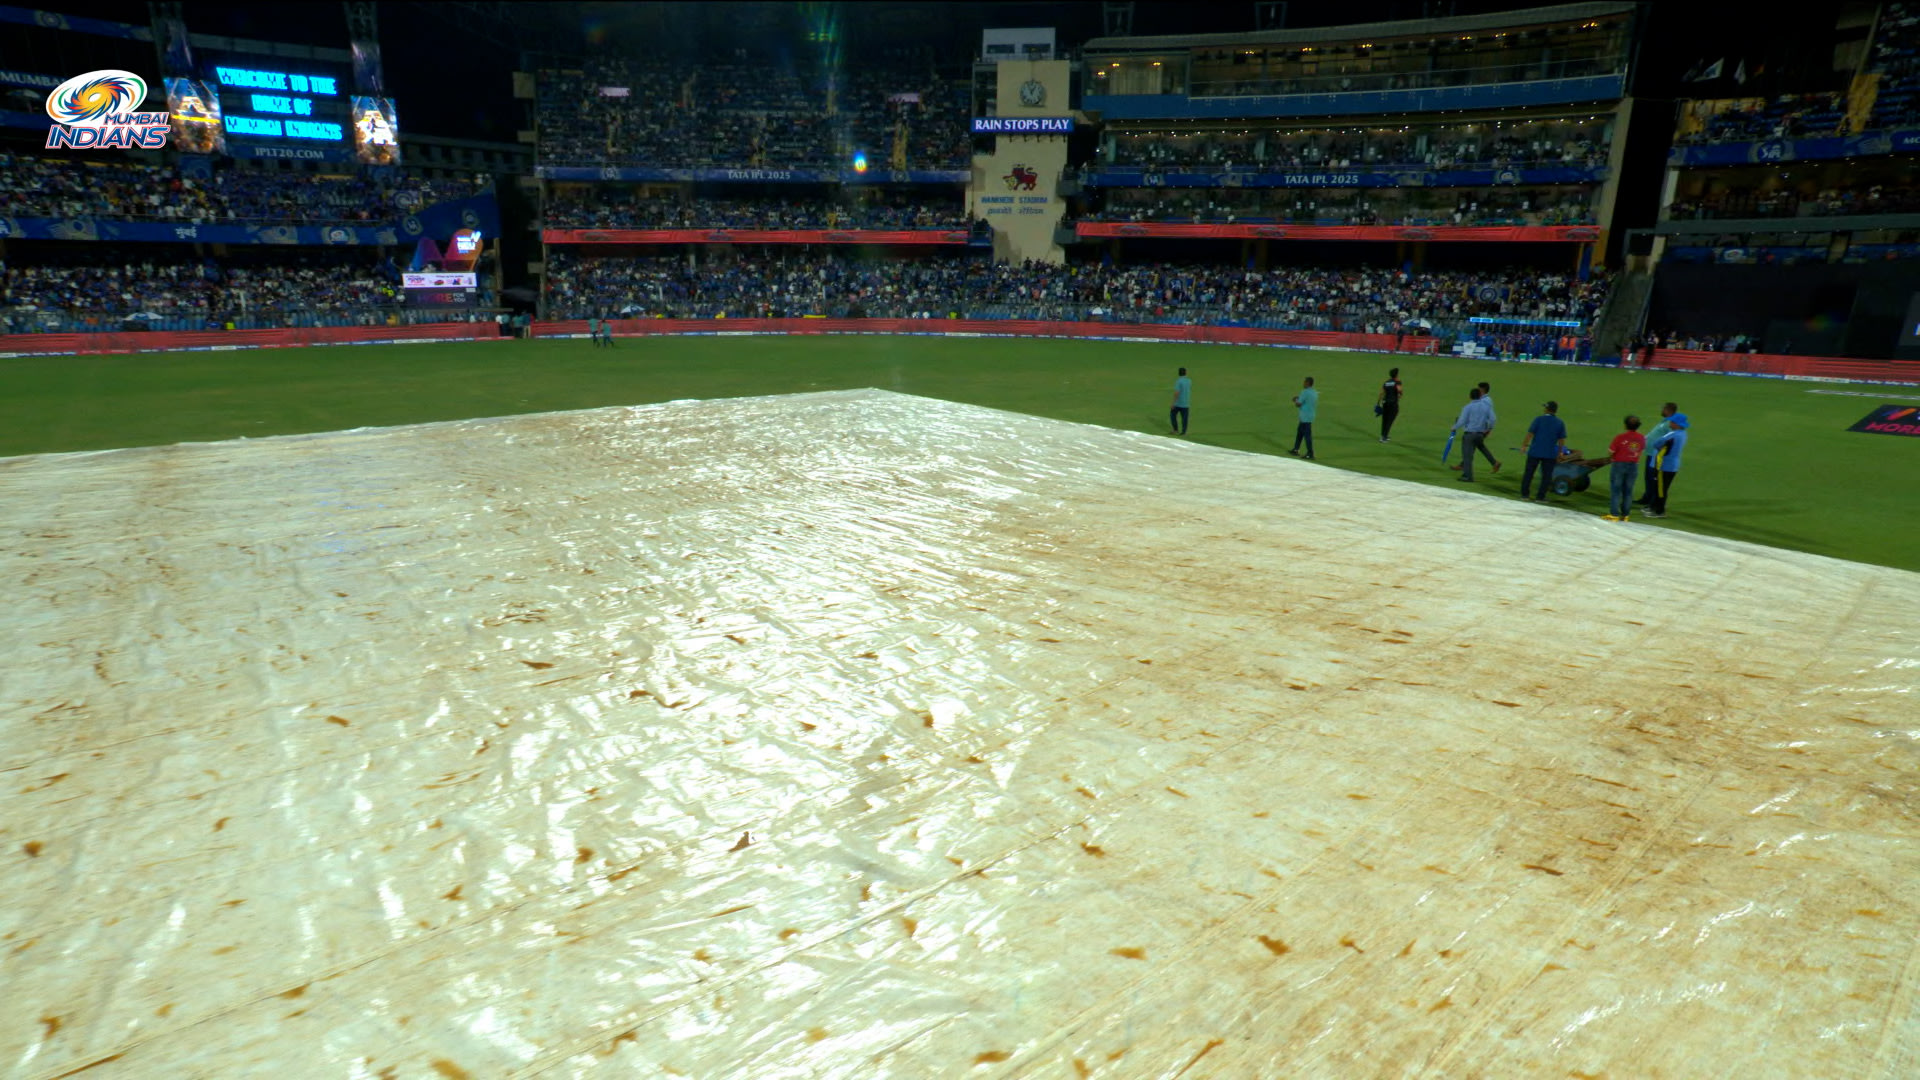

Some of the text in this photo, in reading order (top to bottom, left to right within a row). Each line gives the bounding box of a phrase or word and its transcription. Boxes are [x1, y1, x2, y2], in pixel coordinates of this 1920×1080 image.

[0, 71, 63, 87] MUMBA
[216, 67, 337, 95] WELCOME TO THE
[293, 98, 312, 116] OF
[975, 119, 1069, 130] RAIN STOPS PLAY
[255, 147, 325, 160] IPLT20.COM
[727, 170, 749, 180] TATA
[768, 170, 791, 180] 2025
[1284, 175, 1359, 184] TATA IPL 2025
